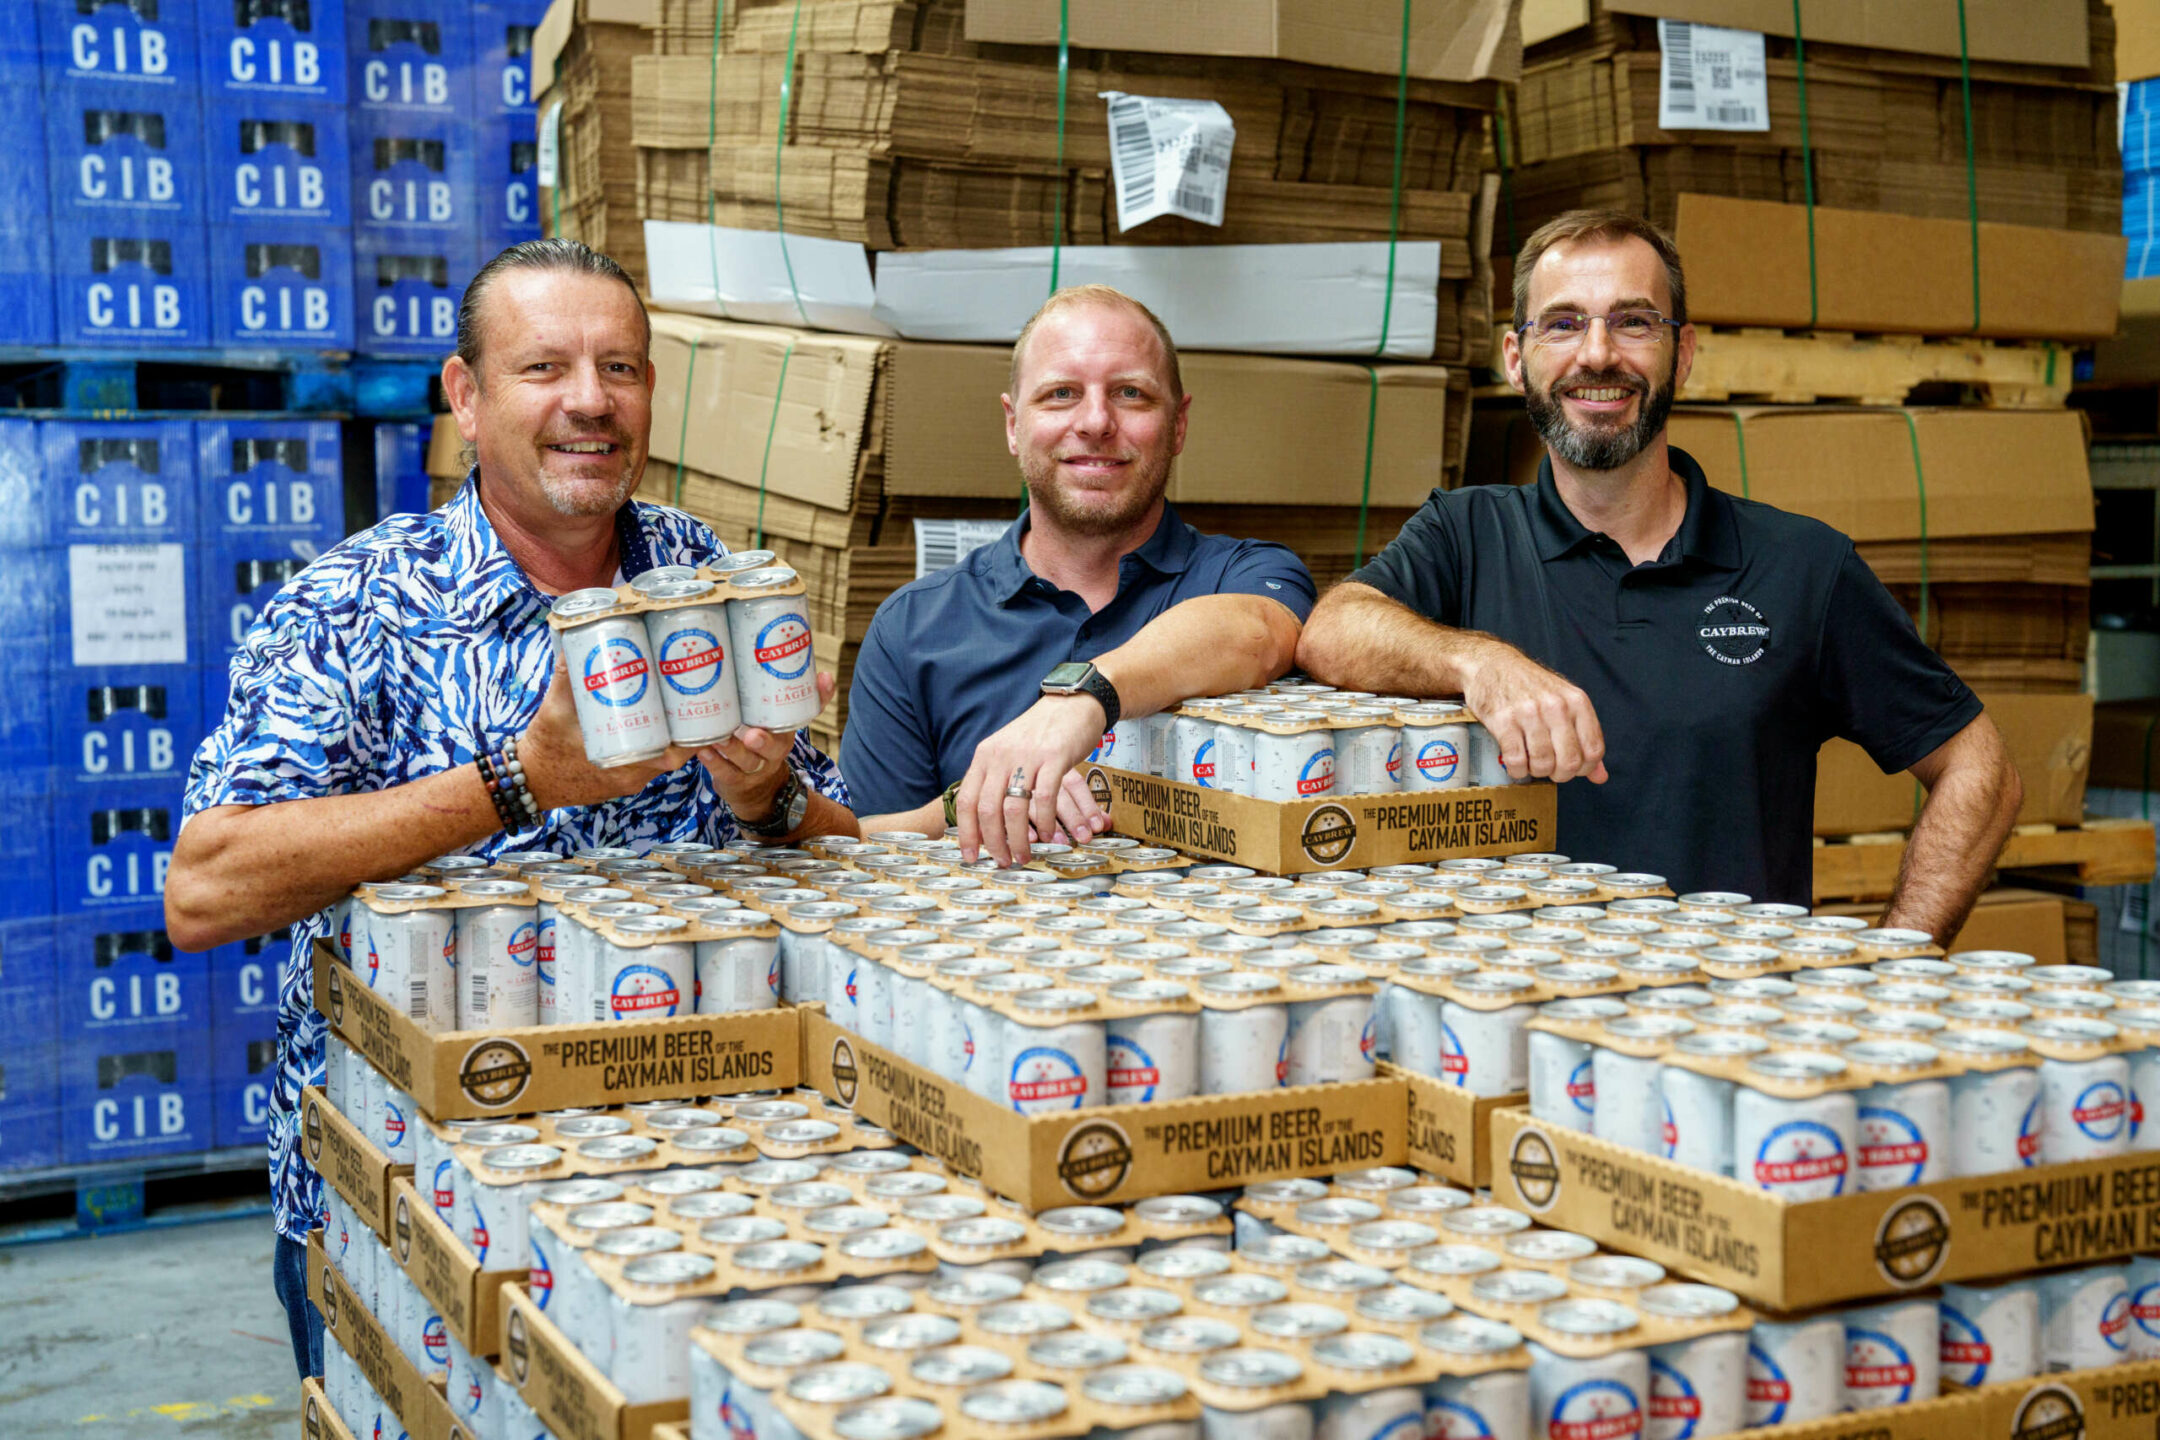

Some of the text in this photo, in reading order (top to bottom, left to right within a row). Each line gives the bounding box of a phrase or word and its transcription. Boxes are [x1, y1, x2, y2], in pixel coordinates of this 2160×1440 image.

[71, 24, 168, 75] CIB
[230, 37, 320, 85] CIB
[365, 61, 449, 104] CIB
[80, 154, 174, 201] CIB
[235, 163, 325, 209] CIB
[370, 179, 453, 222] CIB
[87, 282, 181, 328] CIB
[241, 286, 330, 330] CIB
[373, 296, 455, 337] CIB
[75, 482, 168, 527] CIB
[228, 482, 315, 525] CIB
[662, 651, 720, 673] CAYBREW
[677, 703, 721, 717] LAGER
[82, 728, 175, 774] CIB
[1418, 756, 1457, 768] CAYBREW
[1112, 774, 1122, 787] THE
[1121, 776, 1171, 812] PREMIUM
[1173, 787, 1201, 819] BEER
[1363, 808, 1376, 819] THE
[1377, 802, 1450, 830] PREMIUM
[1455, 799, 1492, 824] BEER
[1143, 809, 1236, 856] CAYMAN ISLANDS
[1304, 825, 1353, 845] CAYBREW
[1409, 819, 1538, 851] CAYMAN ISLANDS
[90, 972, 182, 1020] CIB
[240, 963, 287, 1005] CI
[612, 991, 677, 1009] CAYBREW
[542, 1043, 560, 1056] THE
[561, 1035, 657, 1067] PREMIUM
[664, 1030, 713, 1058] BEER
[603, 1051, 773, 1091] CAYMAN ISLANDS
[93, 1092, 184, 1141] CIB
[1144, 1126, 1161, 1141] THE
[1163, 1115, 1263, 1153] PREMIUM
[1270, 1107, 1321, 1140] BEER
[1208, 1130, 1384, 1180] CAYMAN ISLANDS
[1408, 1119, 1456, 1163] SLANDS
[1578, 1153, 1656, 1200] PREMIUM
[1660, 1178, 1703, 1221] BEER
[1982, 1171, 2104, 1230] PREMIUM
[2112, 1165, 2160, 1209] BEE
[1611, 1197, 1759, 1278] CAYMAN ISLANDS
[2035, 1209, 2136, 1263] CAYMAN
